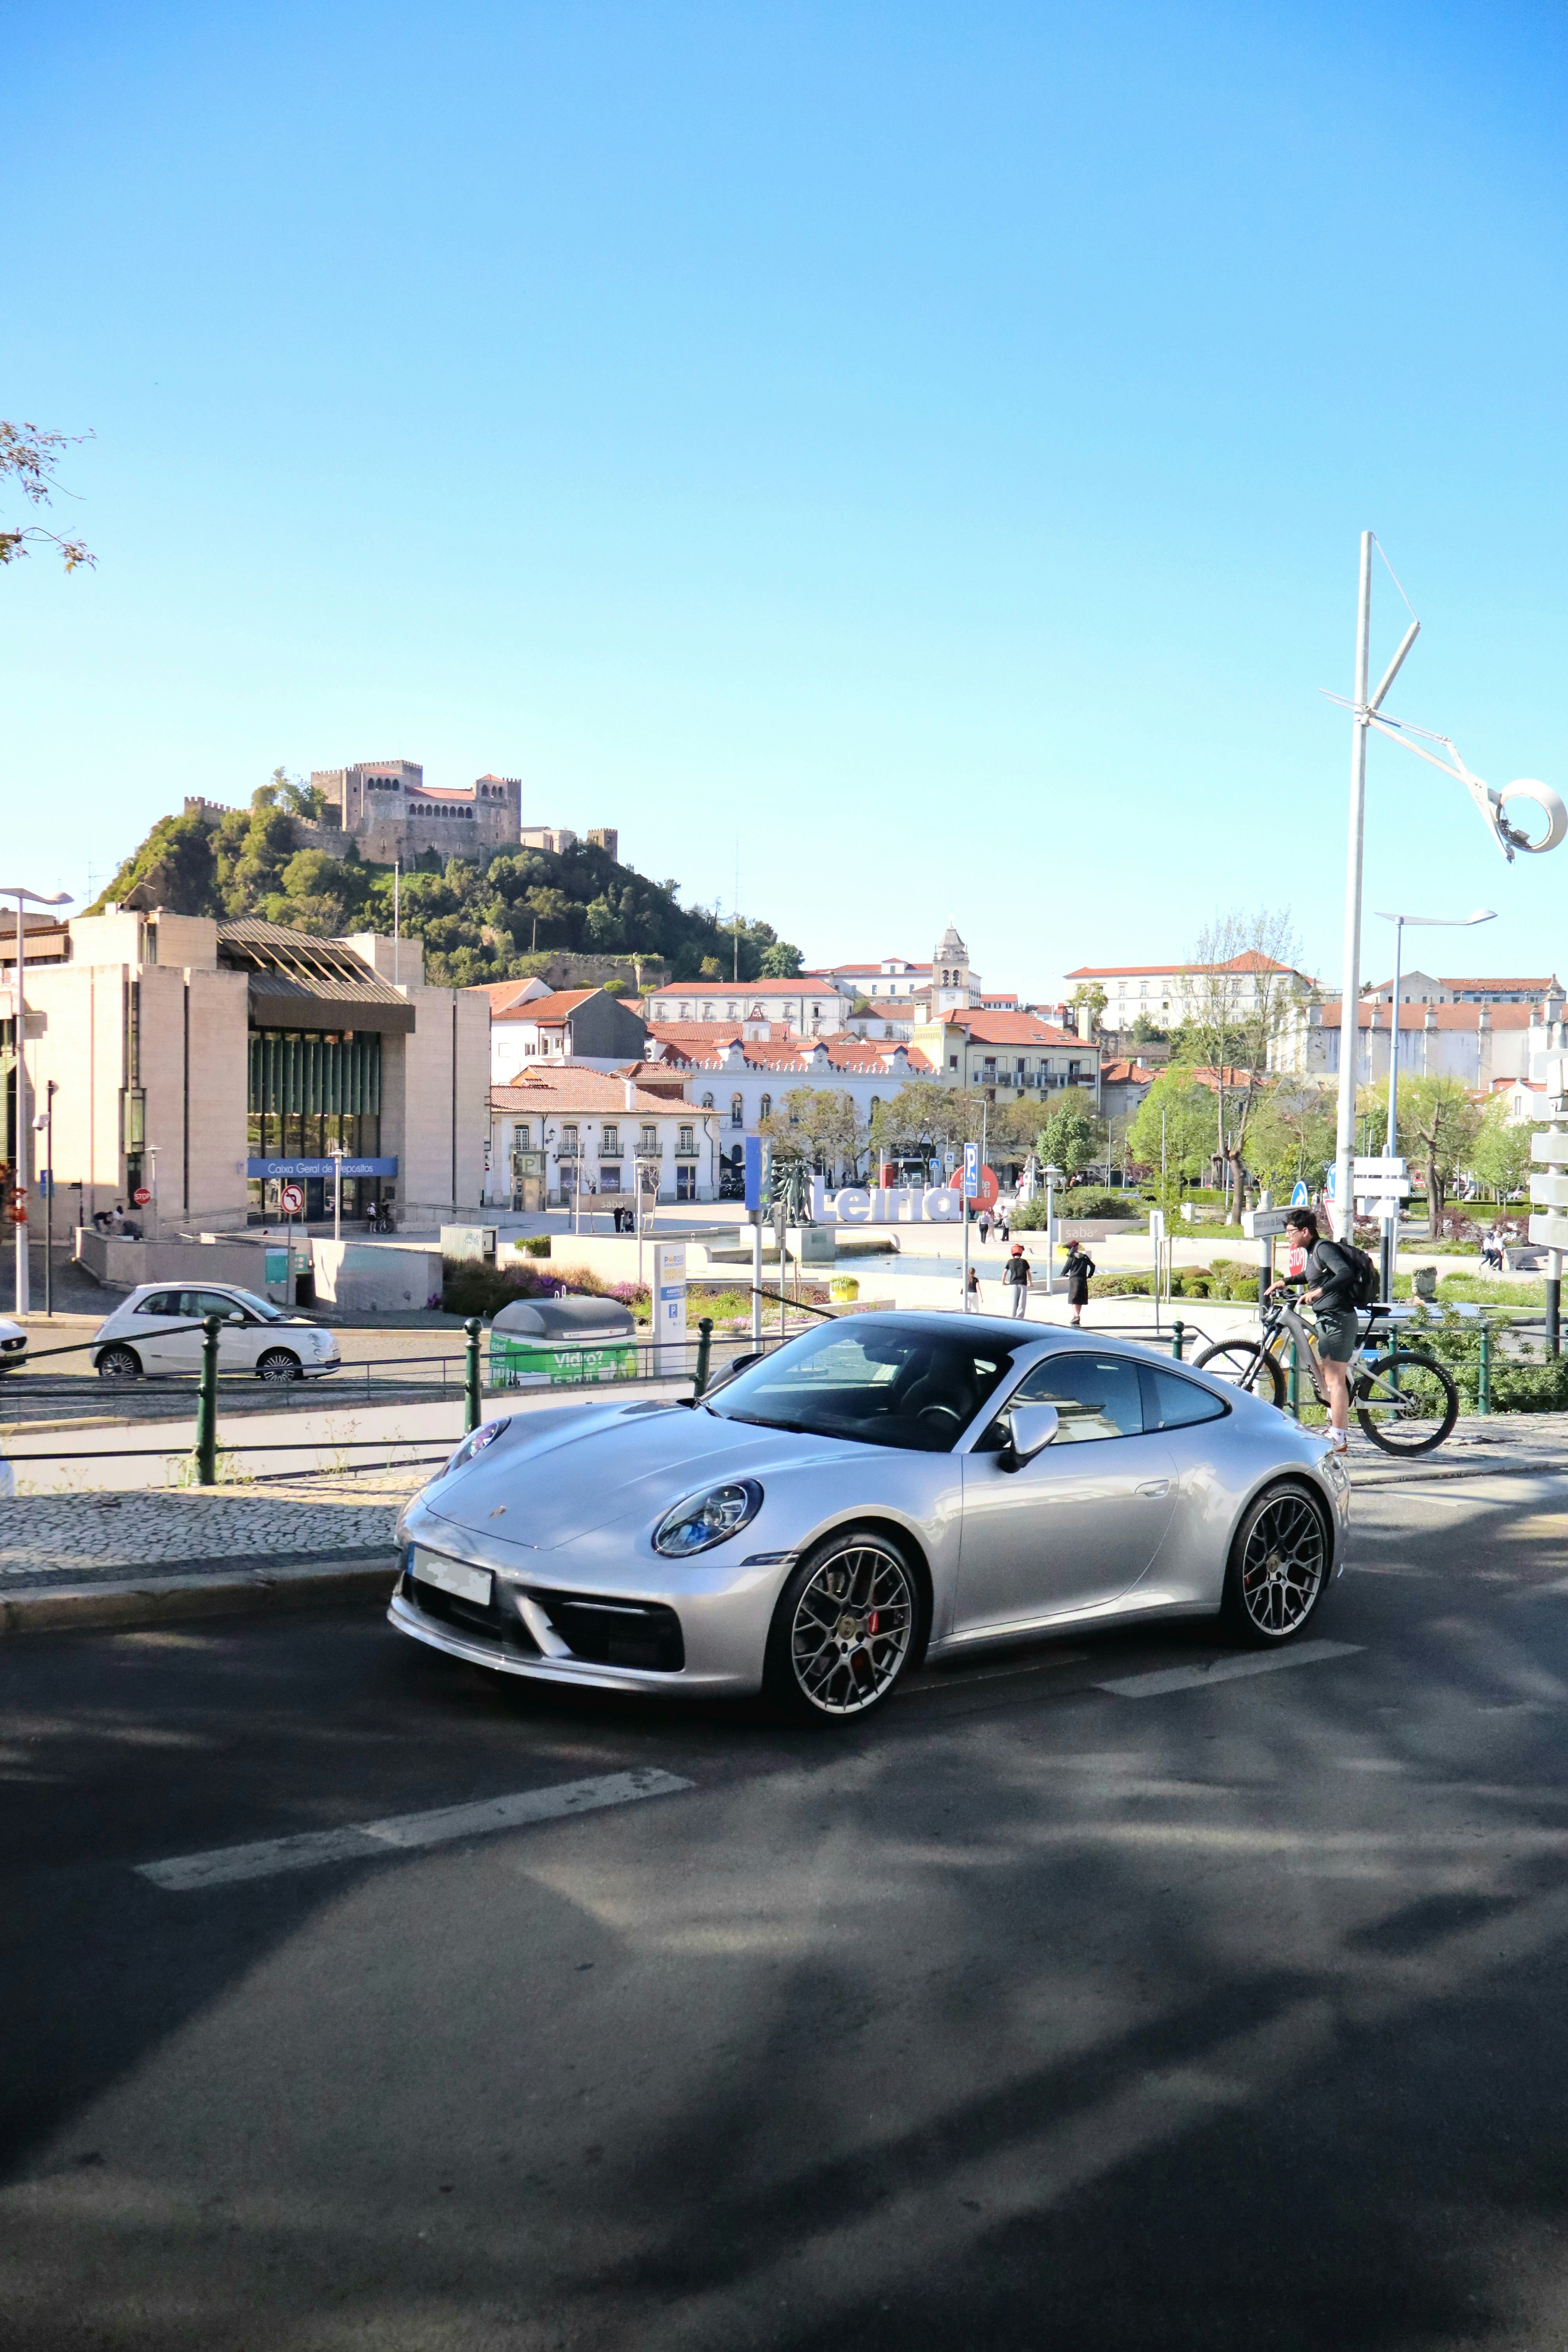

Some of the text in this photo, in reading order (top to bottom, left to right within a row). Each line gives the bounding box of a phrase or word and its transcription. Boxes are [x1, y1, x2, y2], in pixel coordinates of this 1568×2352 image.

[268, 1163, 293, 1173] Caixa
[296, 1163, 319, 1173] Geral
[322, 1164, 333, 1173] de
[525, 1158, 535, 1172] P
[967, 1148, 975, 1177] P
[813, 1175, 960, 1222] Leiria
[1290, 1247, 1303, 1268] STOP
[671, 1306, 676, 1314] P
[490, 1342, 506, 1352] Vidro?
[554, 1350, 603, 1368] Vidro?
